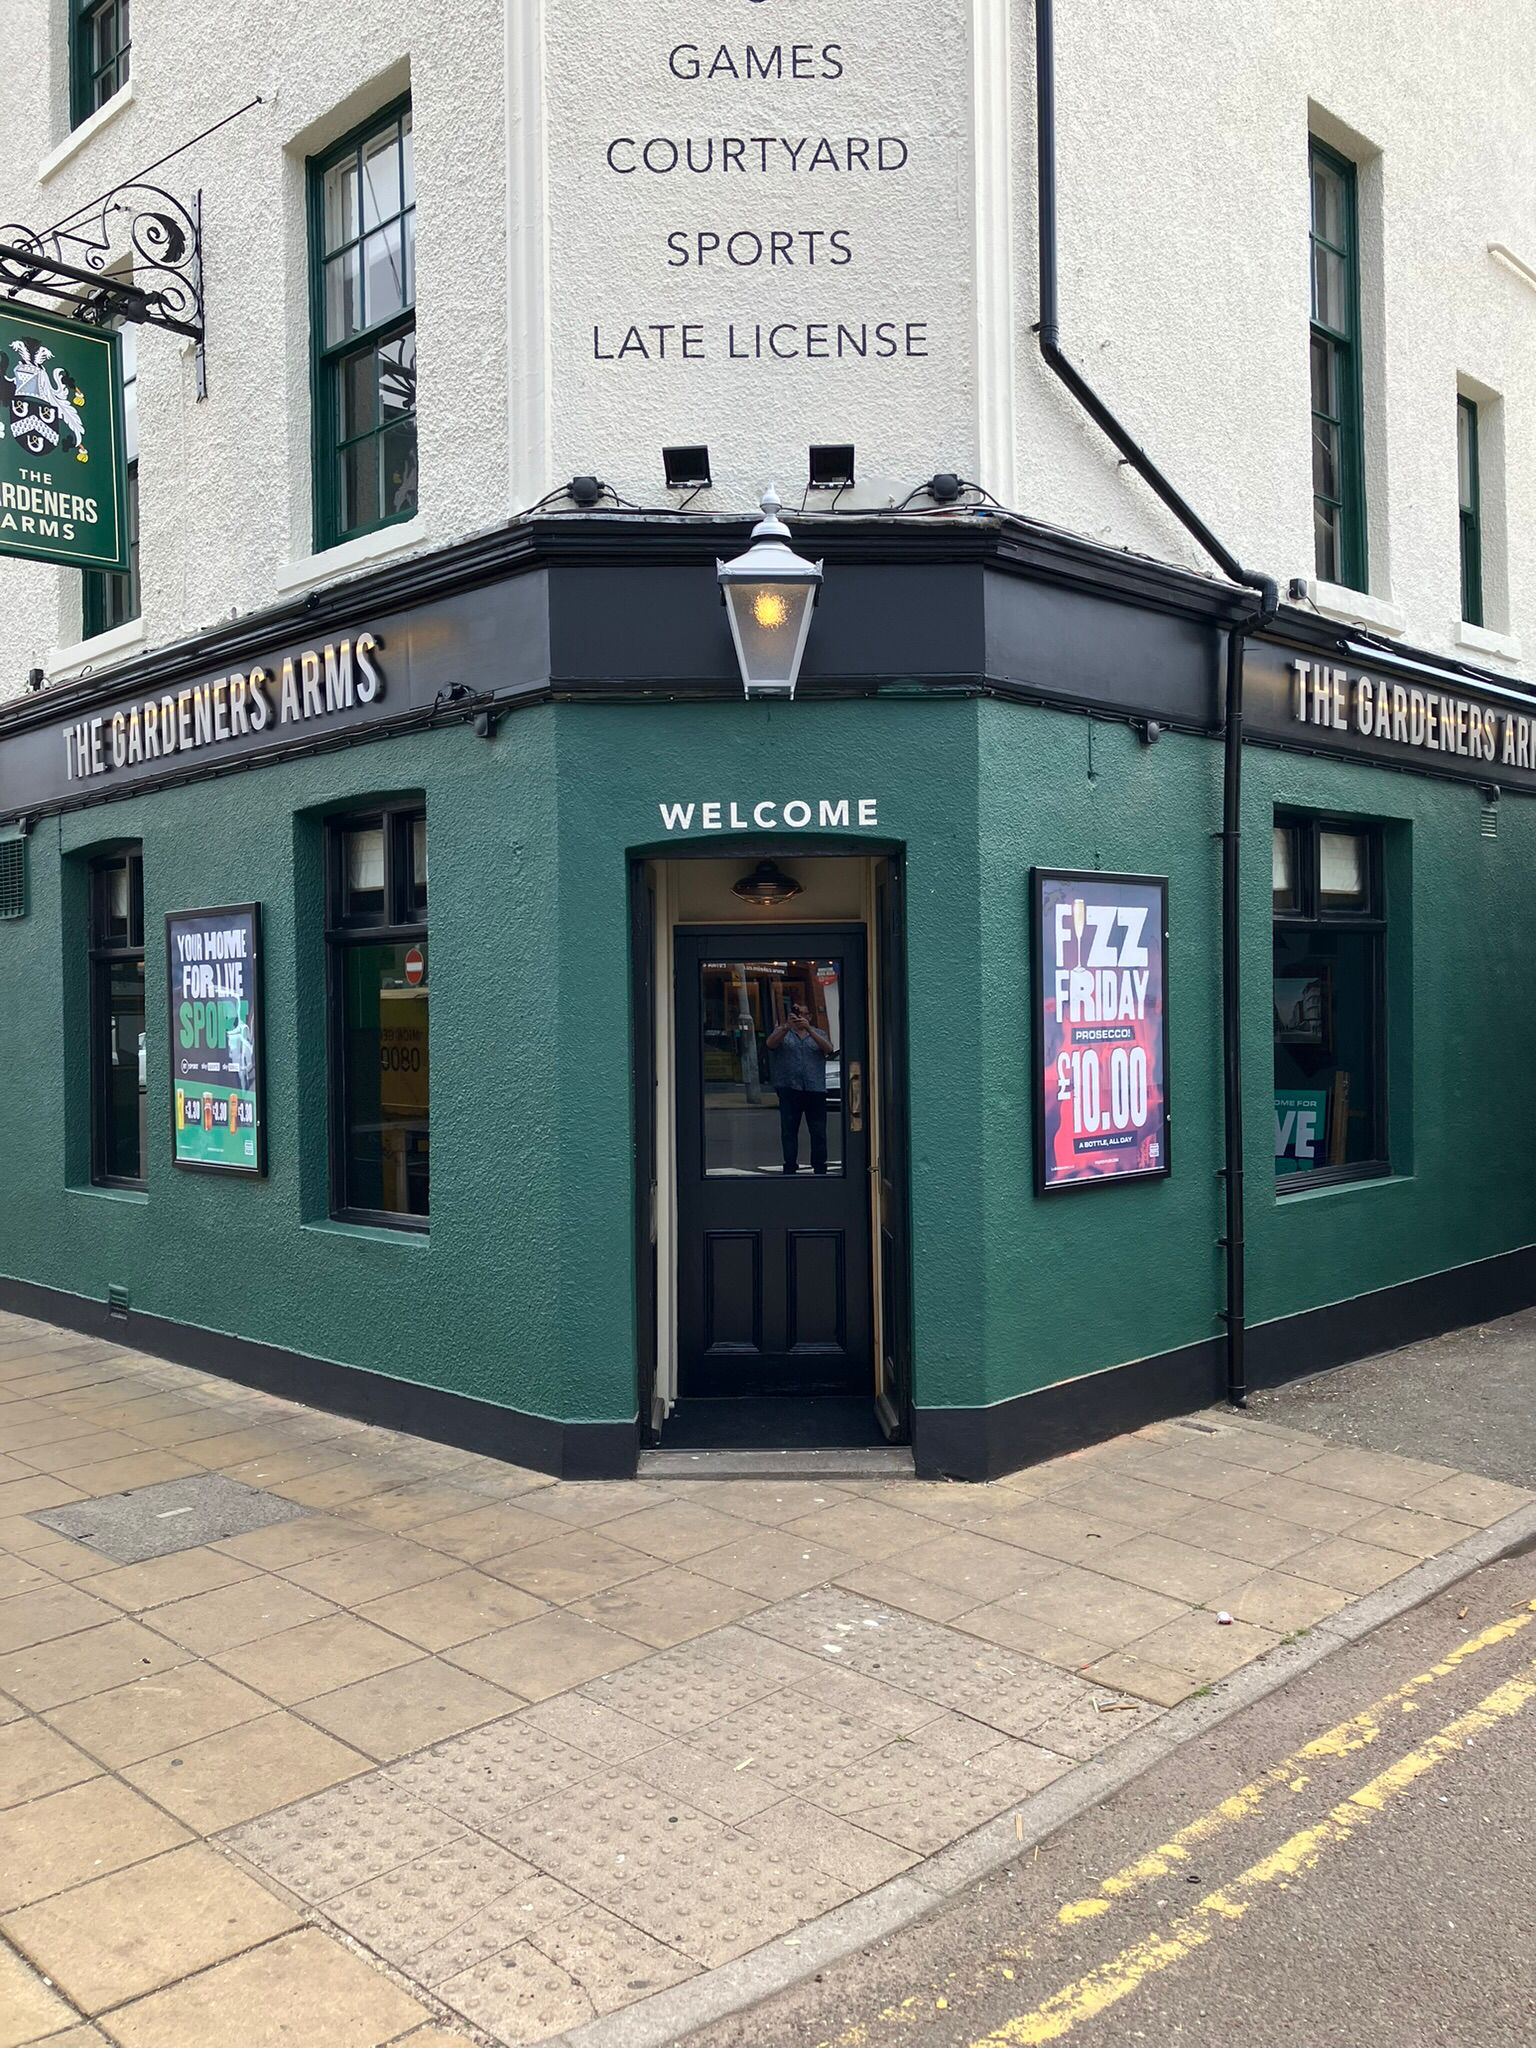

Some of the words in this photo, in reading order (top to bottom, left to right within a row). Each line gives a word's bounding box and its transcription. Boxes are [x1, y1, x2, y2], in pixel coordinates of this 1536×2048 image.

[668, 44, 844, 80] GAMES
[606, 137, 908, 173] COURTYARD
[667, 230, 852, 266] SPORTS
[593, 325, 706, 359] LATE
[729, 323, 929, 358] LICENSE
[19, 468, 52, 485] THE
[0, 482, 98, 524] RDENERS
[0, 513, 75, 540] ARMS
[63, 717, 105, 781] THE
[112, 665, 270, 768] GARDENERS
[281, 632, 379, 724] ARMS
[1294, 659, 1347, 730] THE
[1357, 676, 1496, 762] GARDENERS
[659, 799, 878, 830] WELCOME
[177, 933, 203, 962] YOUR
[204, 929, 247, 960] HOME
[183, 964, 215, 999] FOR
[215, 962, 244, 998] LIVE
[1055, 970, 1149, 1023] FRIDAY
[1075, 1029, 1131, 1040] PROSECCO!
[1057, 1046, 1147, 1133] £10.00
[1297, 1099, 1317, 1107] FOR
[1109, 1137, 1119, 1145] ALL
[1120, 1136, 1133, 1144] DAY
